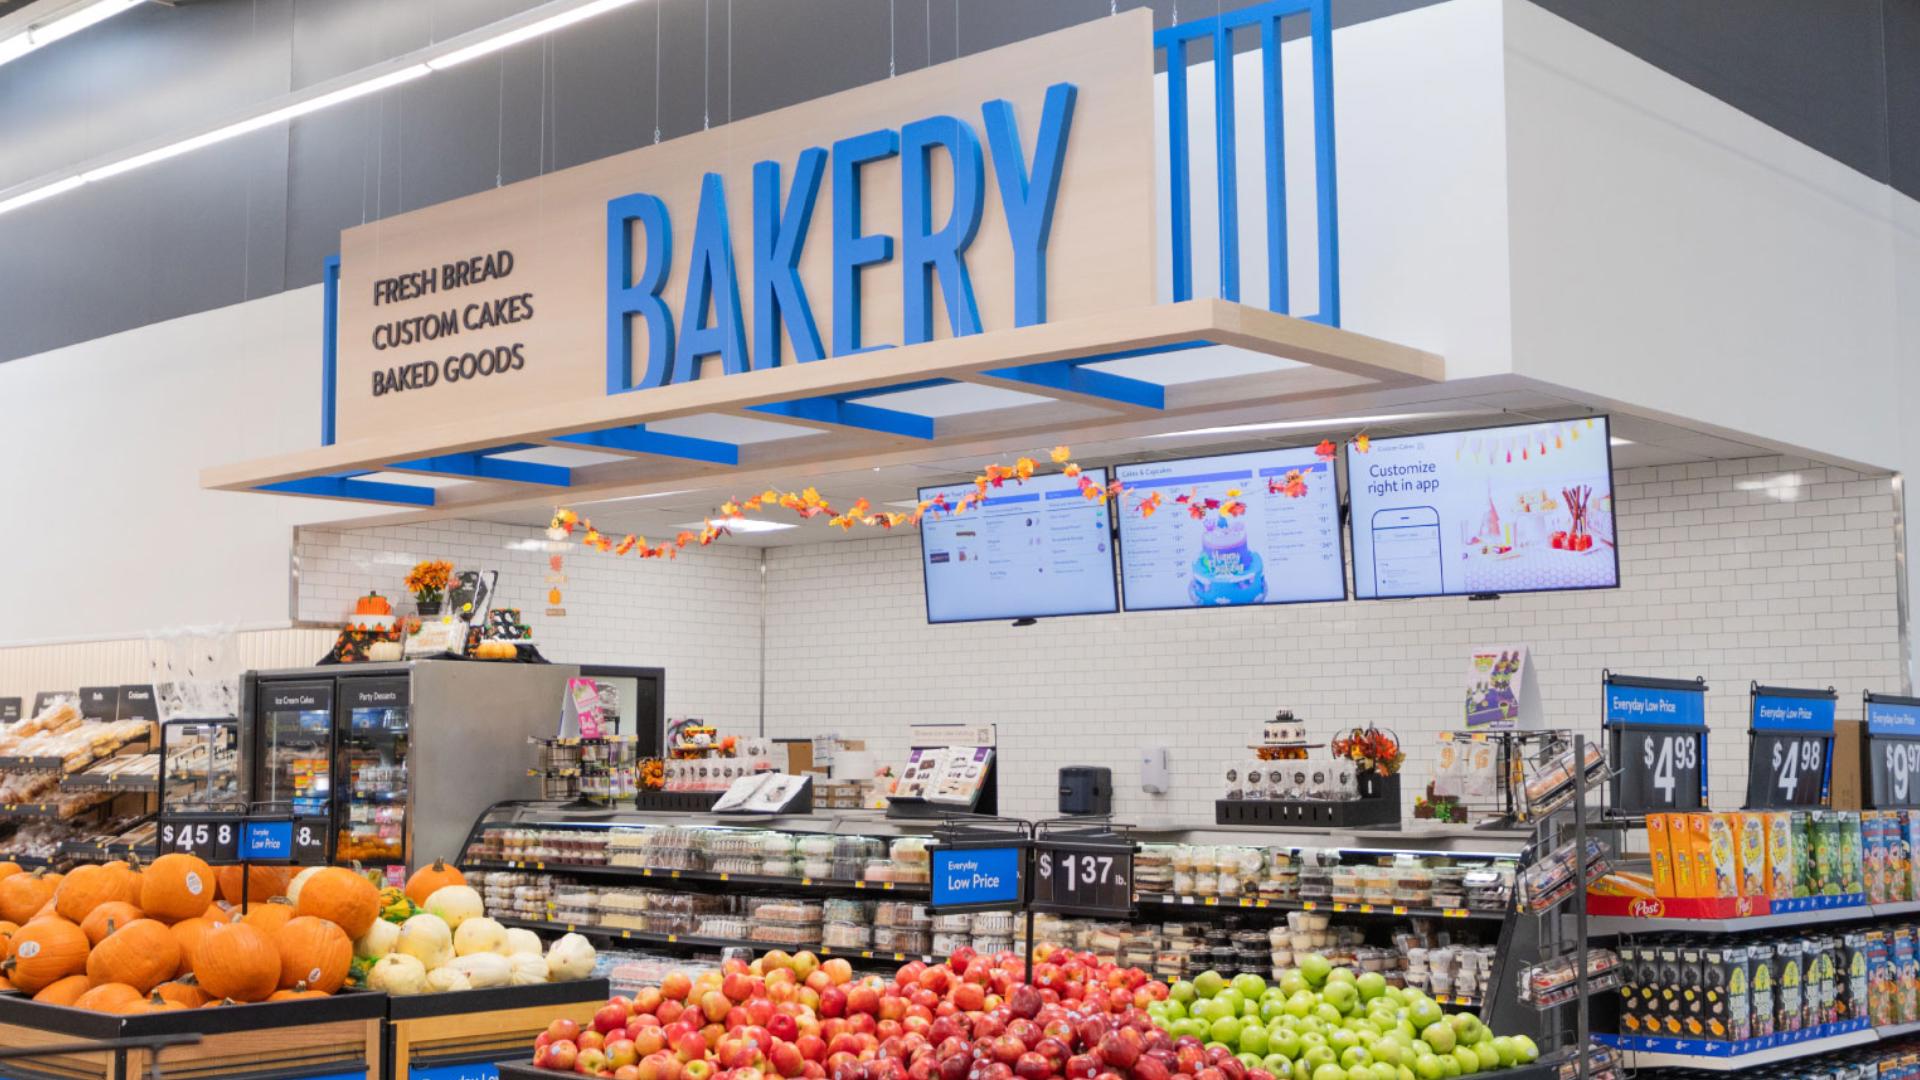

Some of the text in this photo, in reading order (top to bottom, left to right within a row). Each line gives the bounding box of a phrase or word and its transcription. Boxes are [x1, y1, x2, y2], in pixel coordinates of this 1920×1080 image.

[606, 82, 1078, 396] BAKERY
[374, 250, 514, 306] FRESH BREAD
[372, 293, 534, 350] CUSTOM CAKES
[372, 343, 525, 397] BAKED GOODS
[1369, 461, 1437, 478] Customize
[1367, 476, 1440, 496] right in app
[283, 696, 299, 704] Cream
[300, 695, 314, 704] Cakes
[359, 691, 396, 702] Party Desserts
[1613, 696, 1676, 714] Everyday Low Price
[1760, 705, 1812, 721] Everyday Low Price
[252, 828, 269, 836] Everyday
[252, 839, 281, 849] Low Price
[948, 861, 978, 871] Everyday
[948, 875, 970, 890] Low
[972, 874, 1000, 889] Price
[1114, 874, 1127, 886] lb.
[1635, 901, 1659, 917] Post
